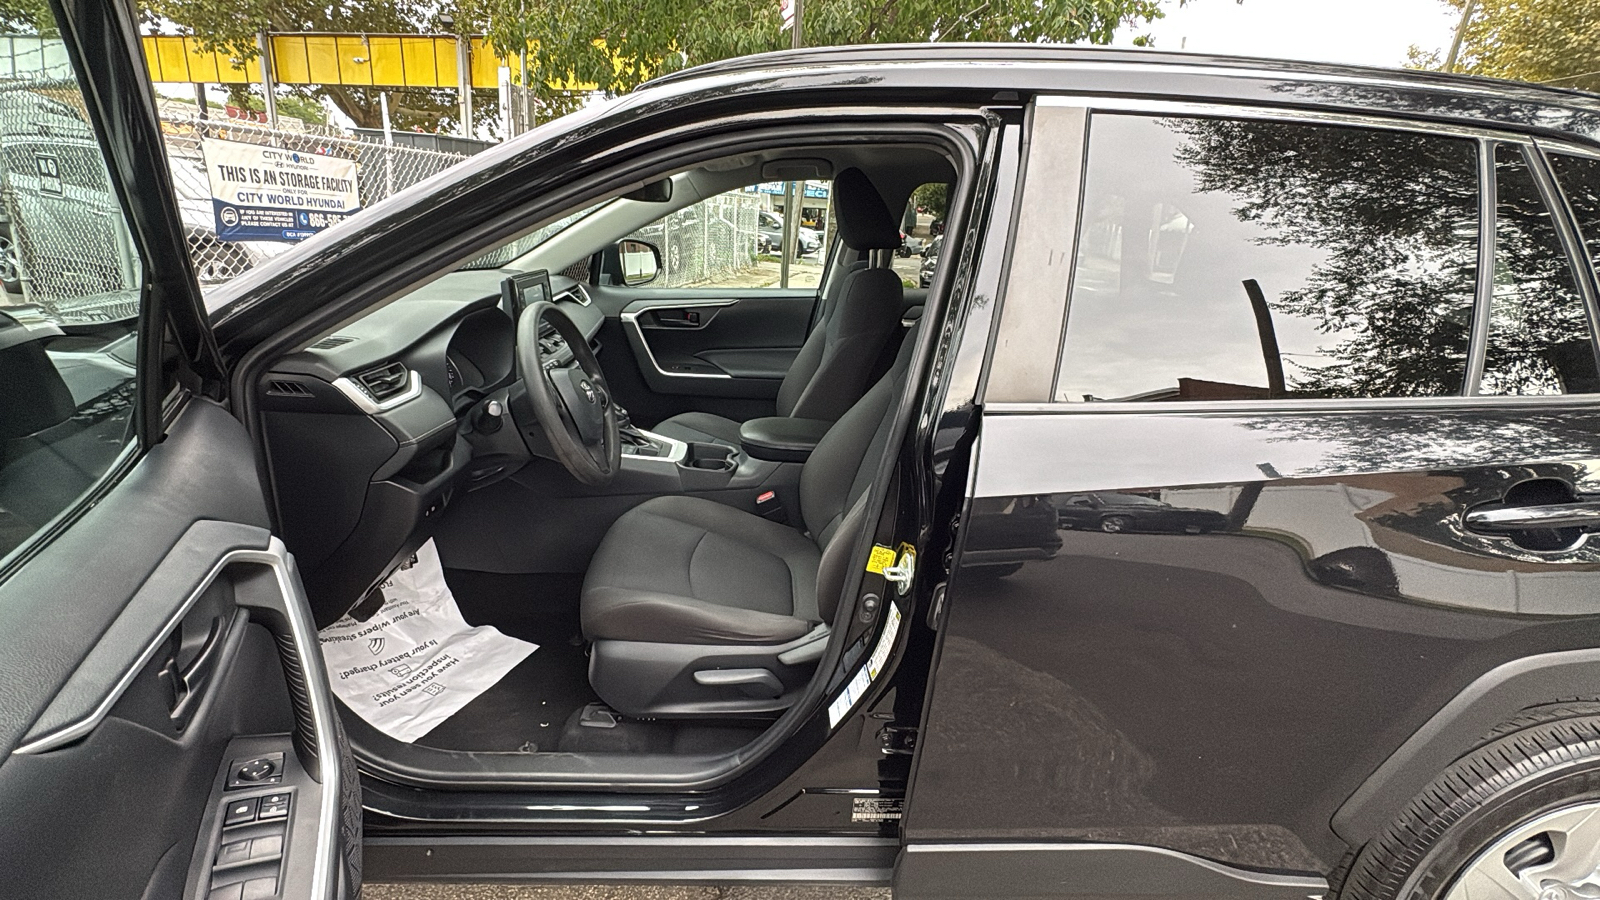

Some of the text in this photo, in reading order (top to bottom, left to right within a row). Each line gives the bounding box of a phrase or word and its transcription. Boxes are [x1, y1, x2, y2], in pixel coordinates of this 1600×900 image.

[262, 150, 282, 161] CITY
[218, 165, 353, 193] THIS IS AN STORAGE FACILITY
[237, 192, 345, 209] CITY WORLD HYUNDAI
[380, 580, 393, 590] FLO
[392, 611, 409, 623] your
[408, 608, 420, 616] Are
[358, 621, 390, 637] wipers
[411, 641, 430, 654] your
[378, 652, 409, 668] battery
[339, 663, 378, 680] charged?
[372, 654, 451, 701] inspection results?
[379, 658, 459, 708] Have you seen your
